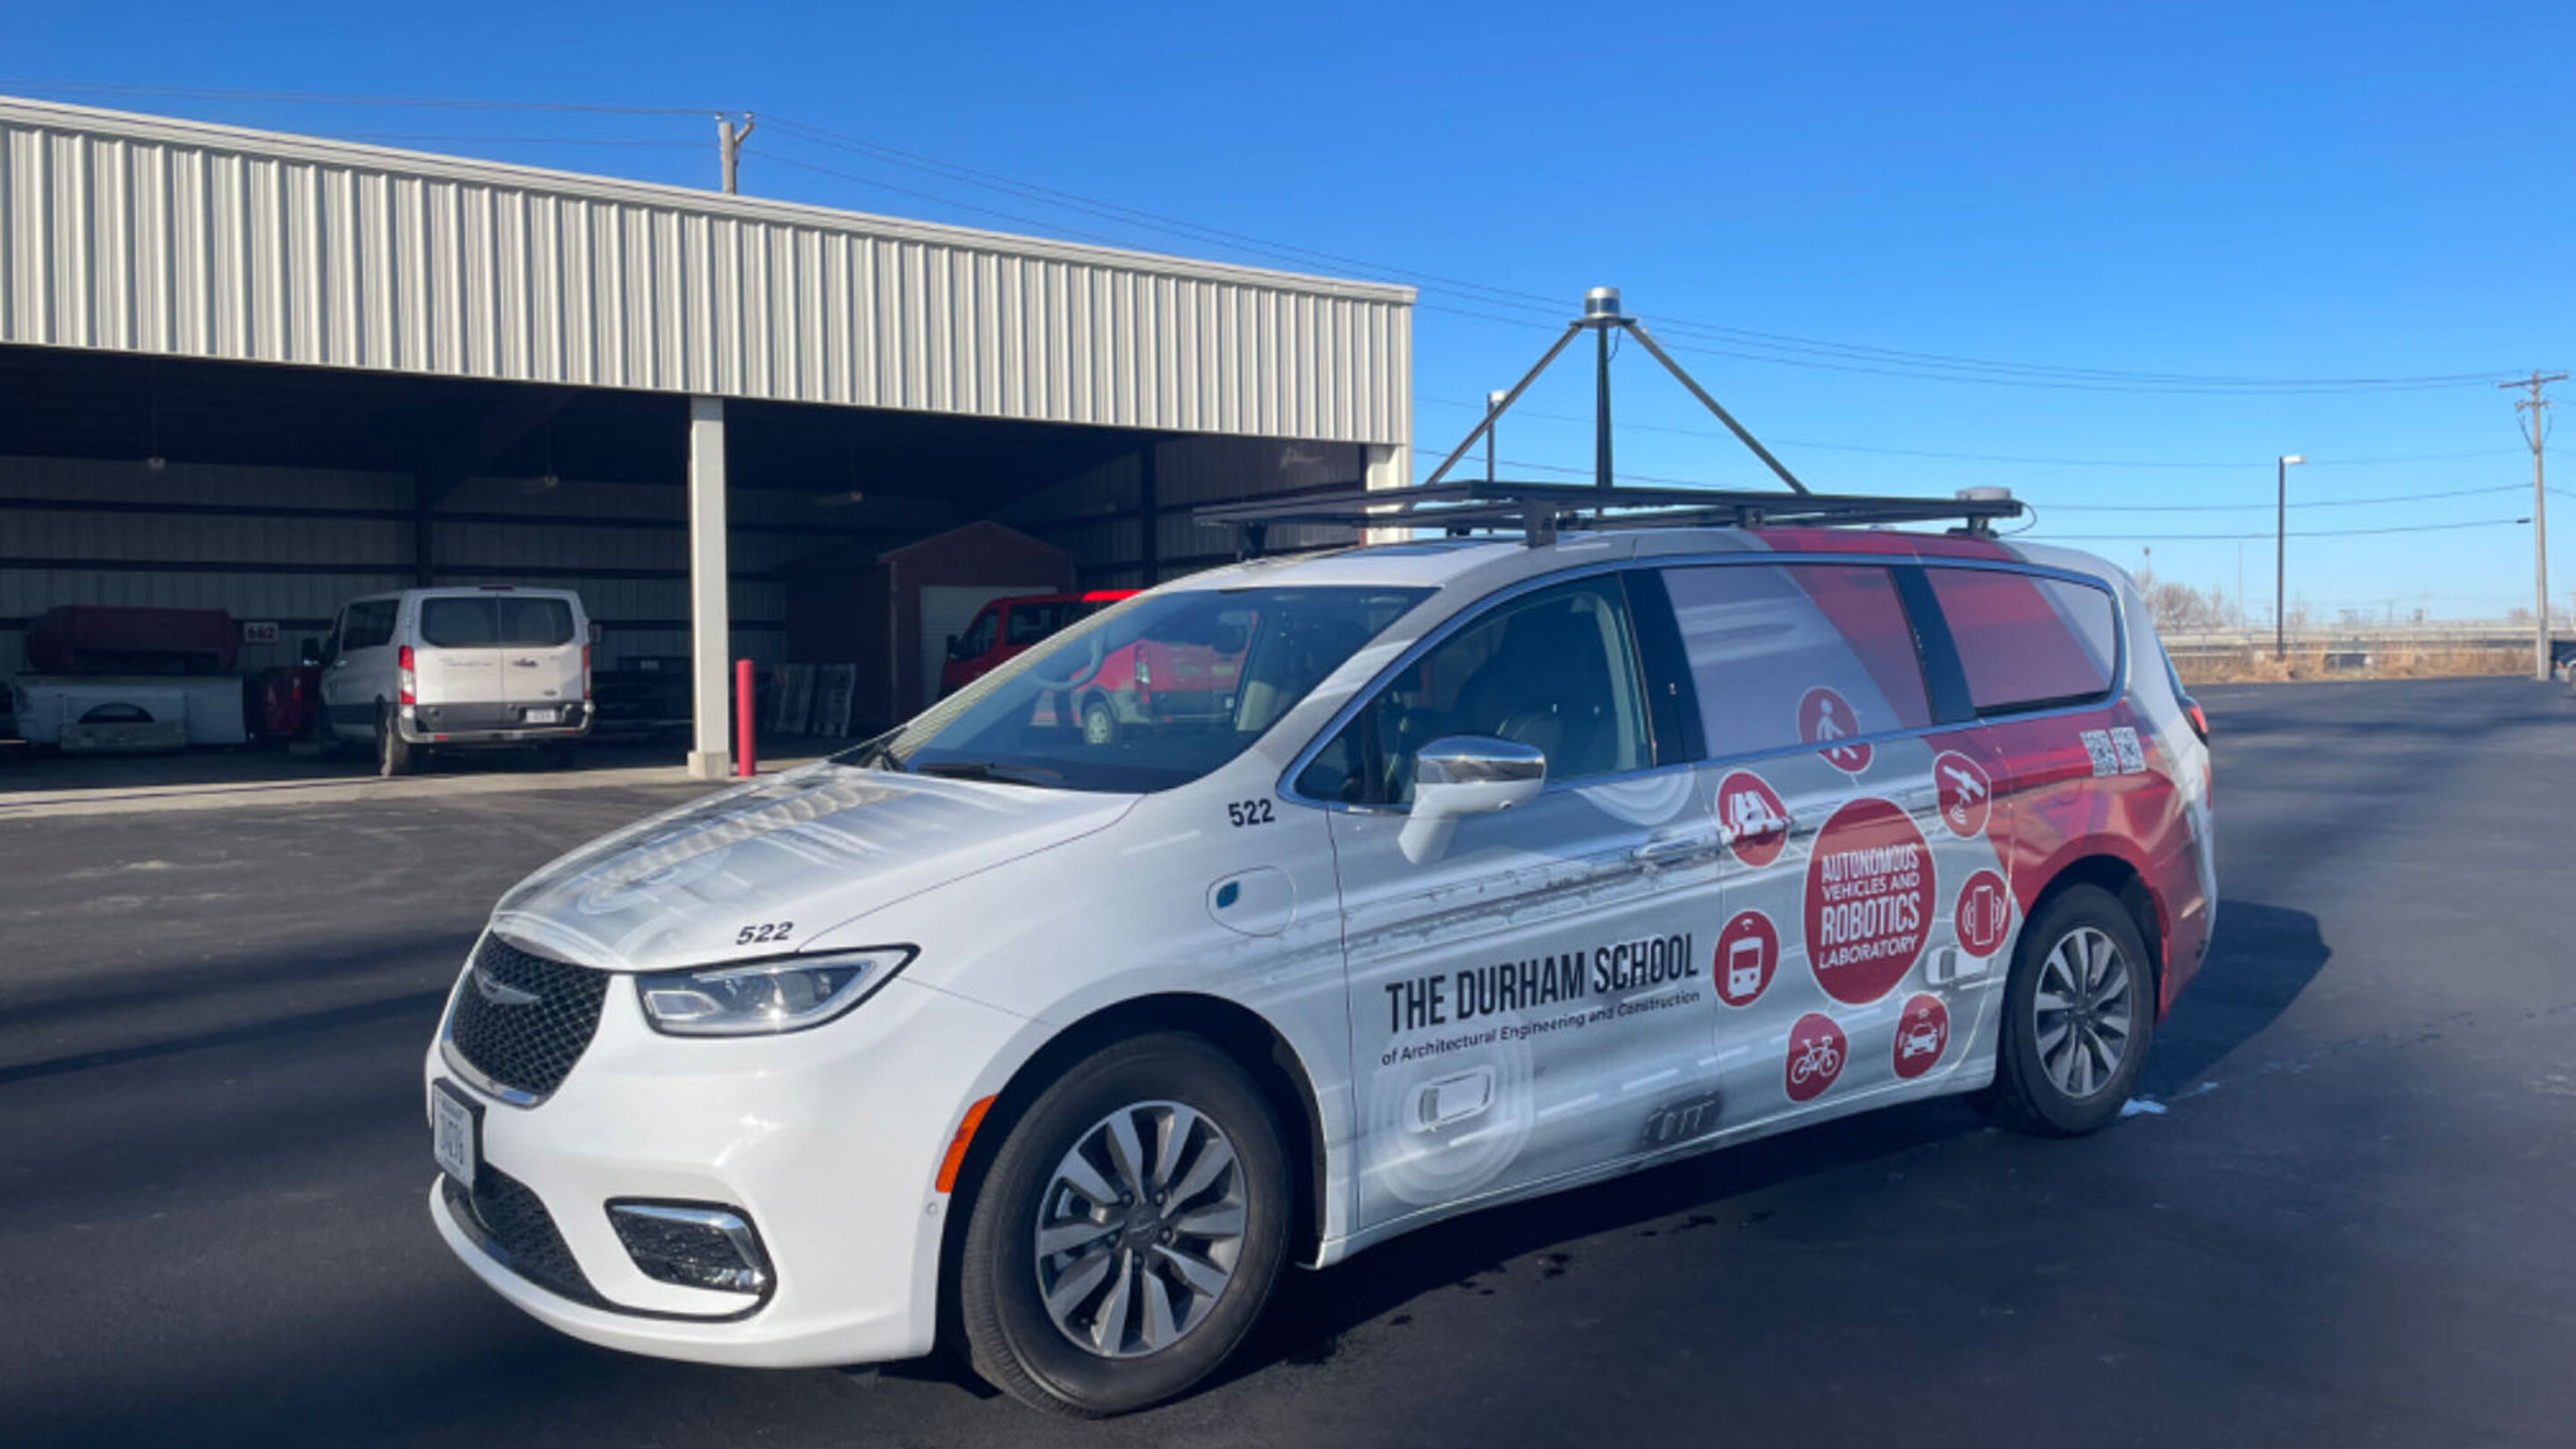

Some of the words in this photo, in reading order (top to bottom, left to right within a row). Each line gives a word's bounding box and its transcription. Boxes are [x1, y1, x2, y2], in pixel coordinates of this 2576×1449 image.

[1228, 798, 1275, 827] 522
[1822, 843, 1919, 882] AUTONOMOUS
[1822, 877, 1885, 900] VEHICLES
[1892, 872, 1919, 889] AND
[736, 921, 793, 945] 522
[1822, 892, 1919, 945] ROBOTICS
[1819, 936, 1918, 968] LABORATORY
[1385, 974, 1446, 1034] THE
[1457, 951, 1585, 1020] DURHAM
[1594, 932, 1698, 994] SCHOOL
[1382, 1046, 1398, 1066] of
[1401, 1029, 1497, 1063] Architectural
[1500, 1013, 1585, 1040] Engineering
[1589, 1004, 1613, 1023] and
[1617, 990, 1699, 1017] Construction
